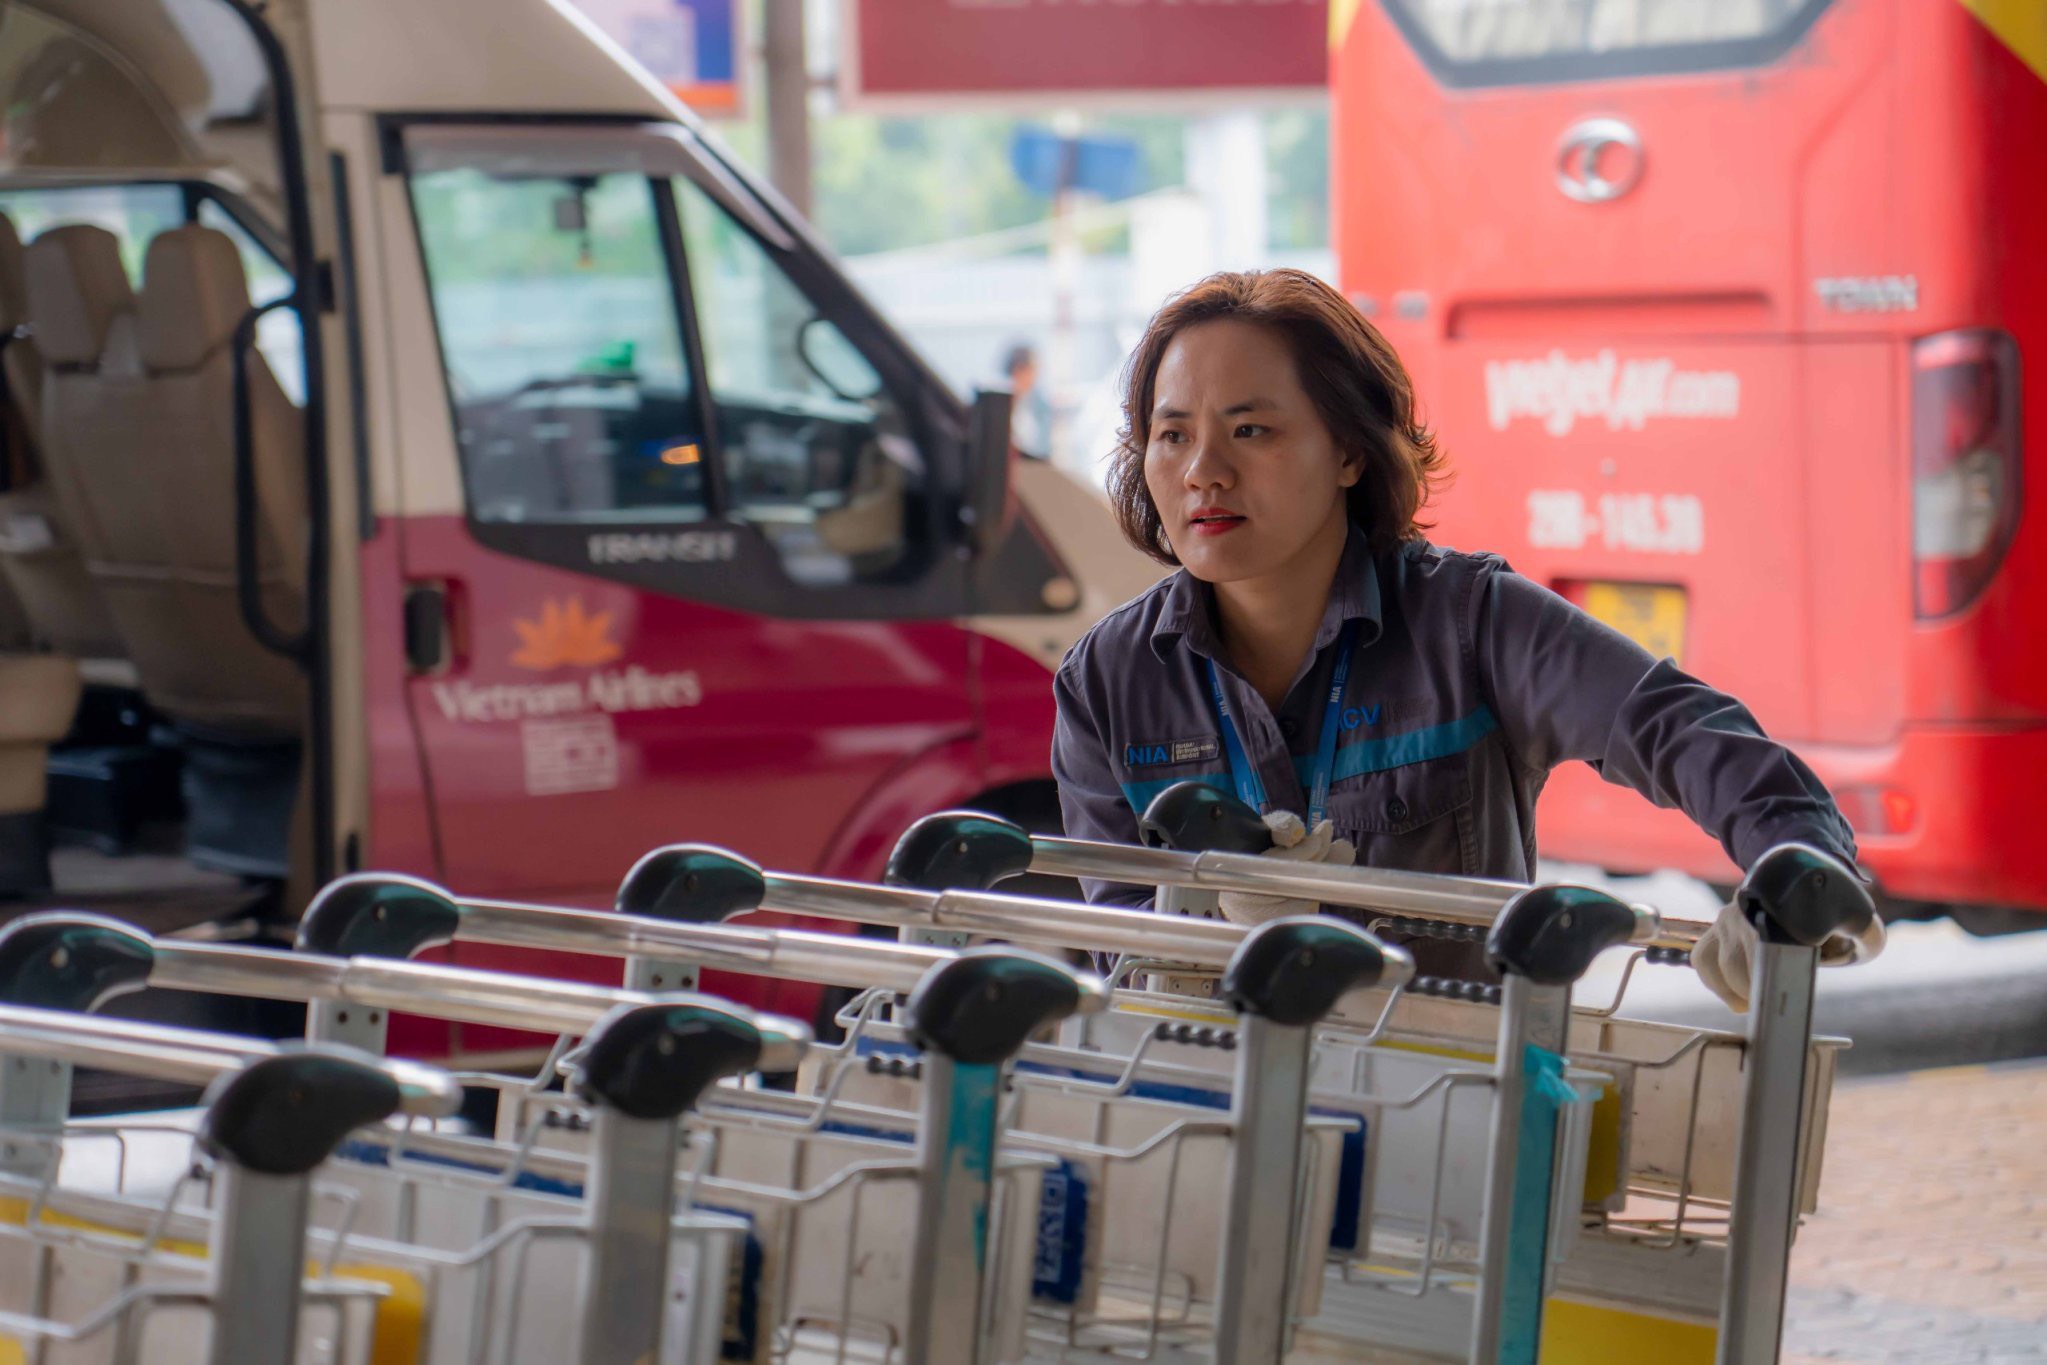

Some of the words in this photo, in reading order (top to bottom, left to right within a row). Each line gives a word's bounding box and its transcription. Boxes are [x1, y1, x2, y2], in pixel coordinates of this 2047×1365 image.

[588, 532, 736, 563] TRANSIT
[432, 681, 583, 722] Vietnam
[588, 666, 702, 713] Airlines
[1339, 703, 1382, 732] CV
[1128, 746, 1169, 765] NIA
